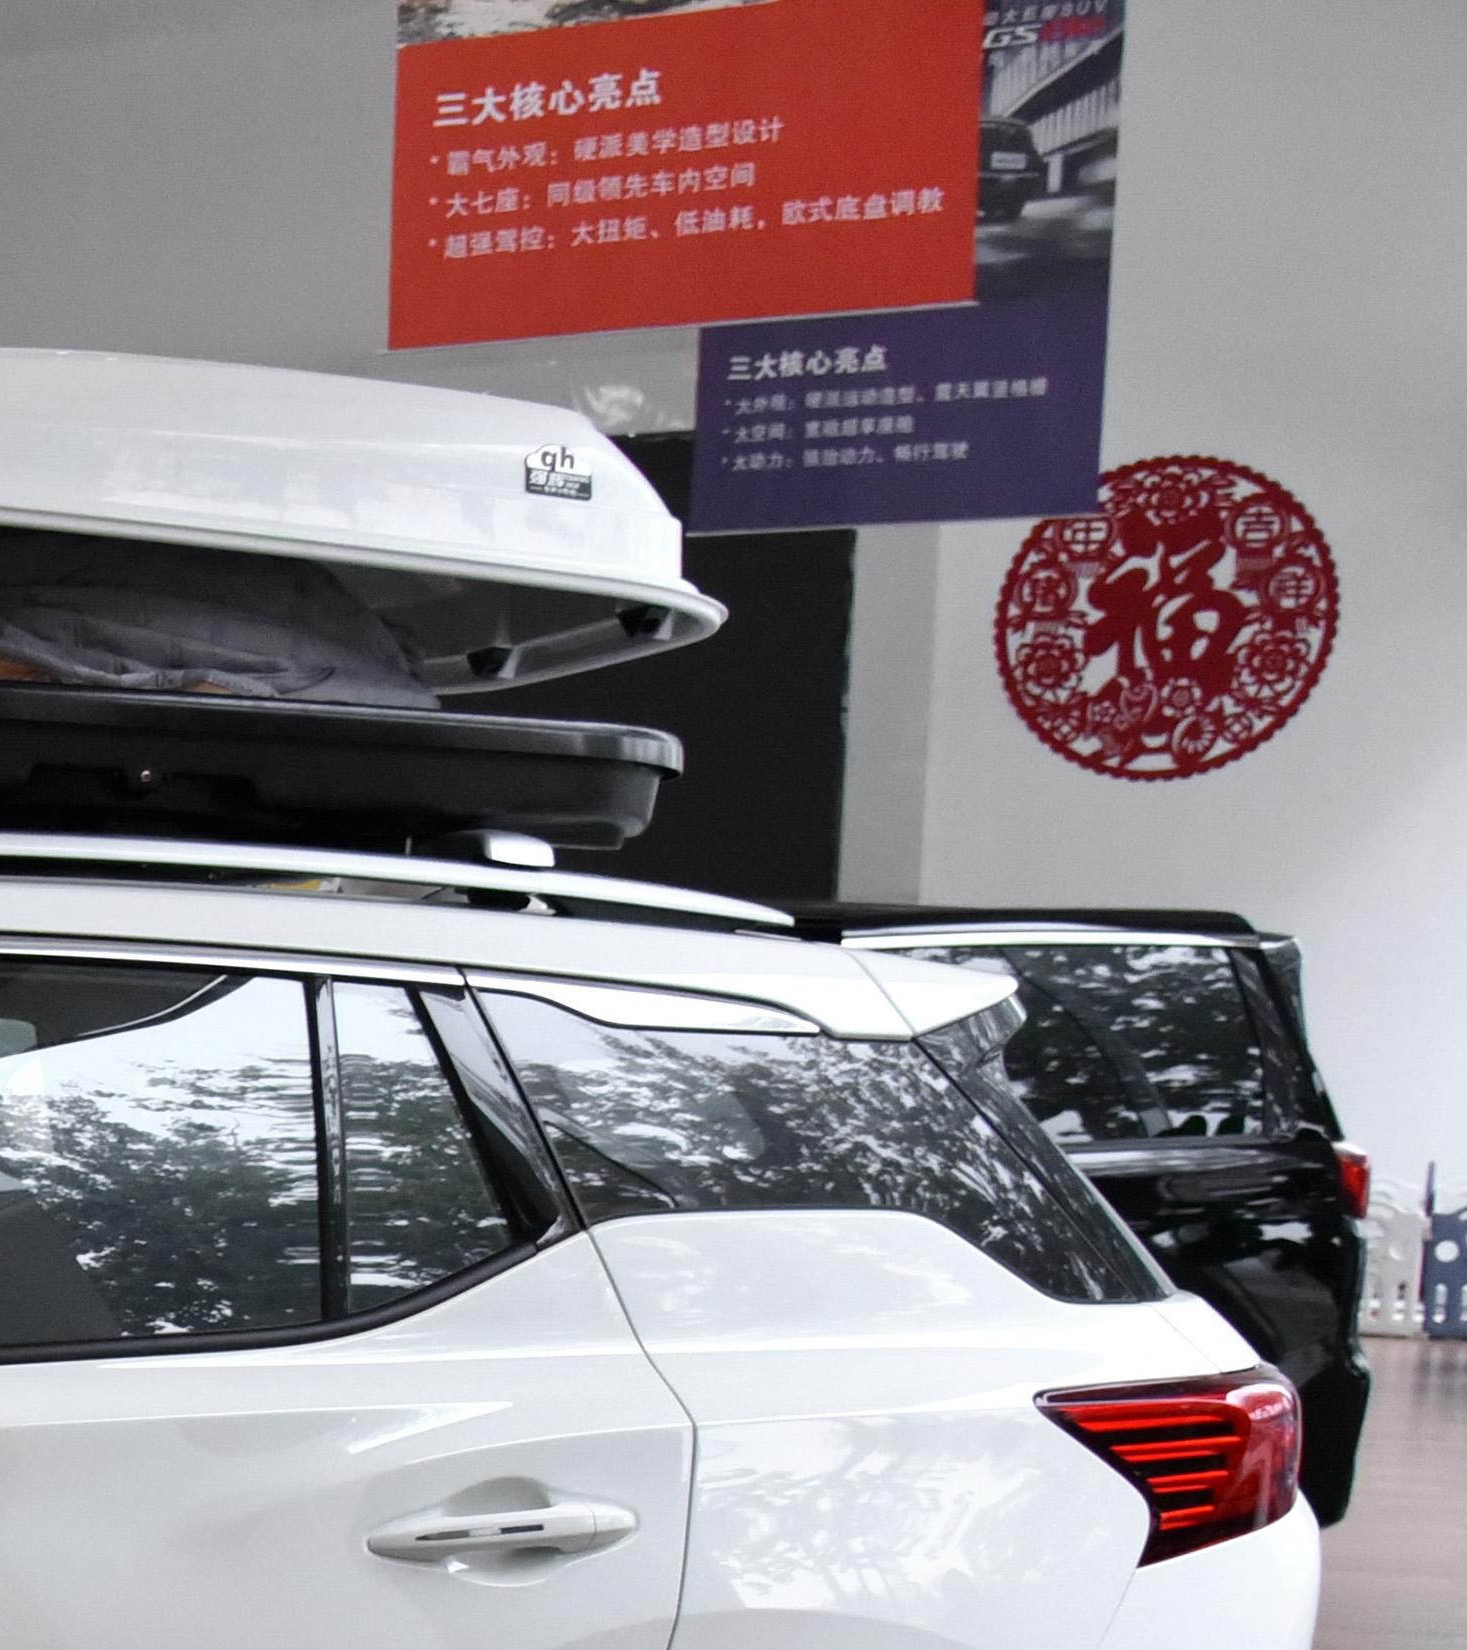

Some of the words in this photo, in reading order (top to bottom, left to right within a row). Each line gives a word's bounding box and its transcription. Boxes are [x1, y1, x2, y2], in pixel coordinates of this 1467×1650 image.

[433, 68, 663, 127] 三大核心亮点
[728, 345, 887, 381] 三大核心亮点
